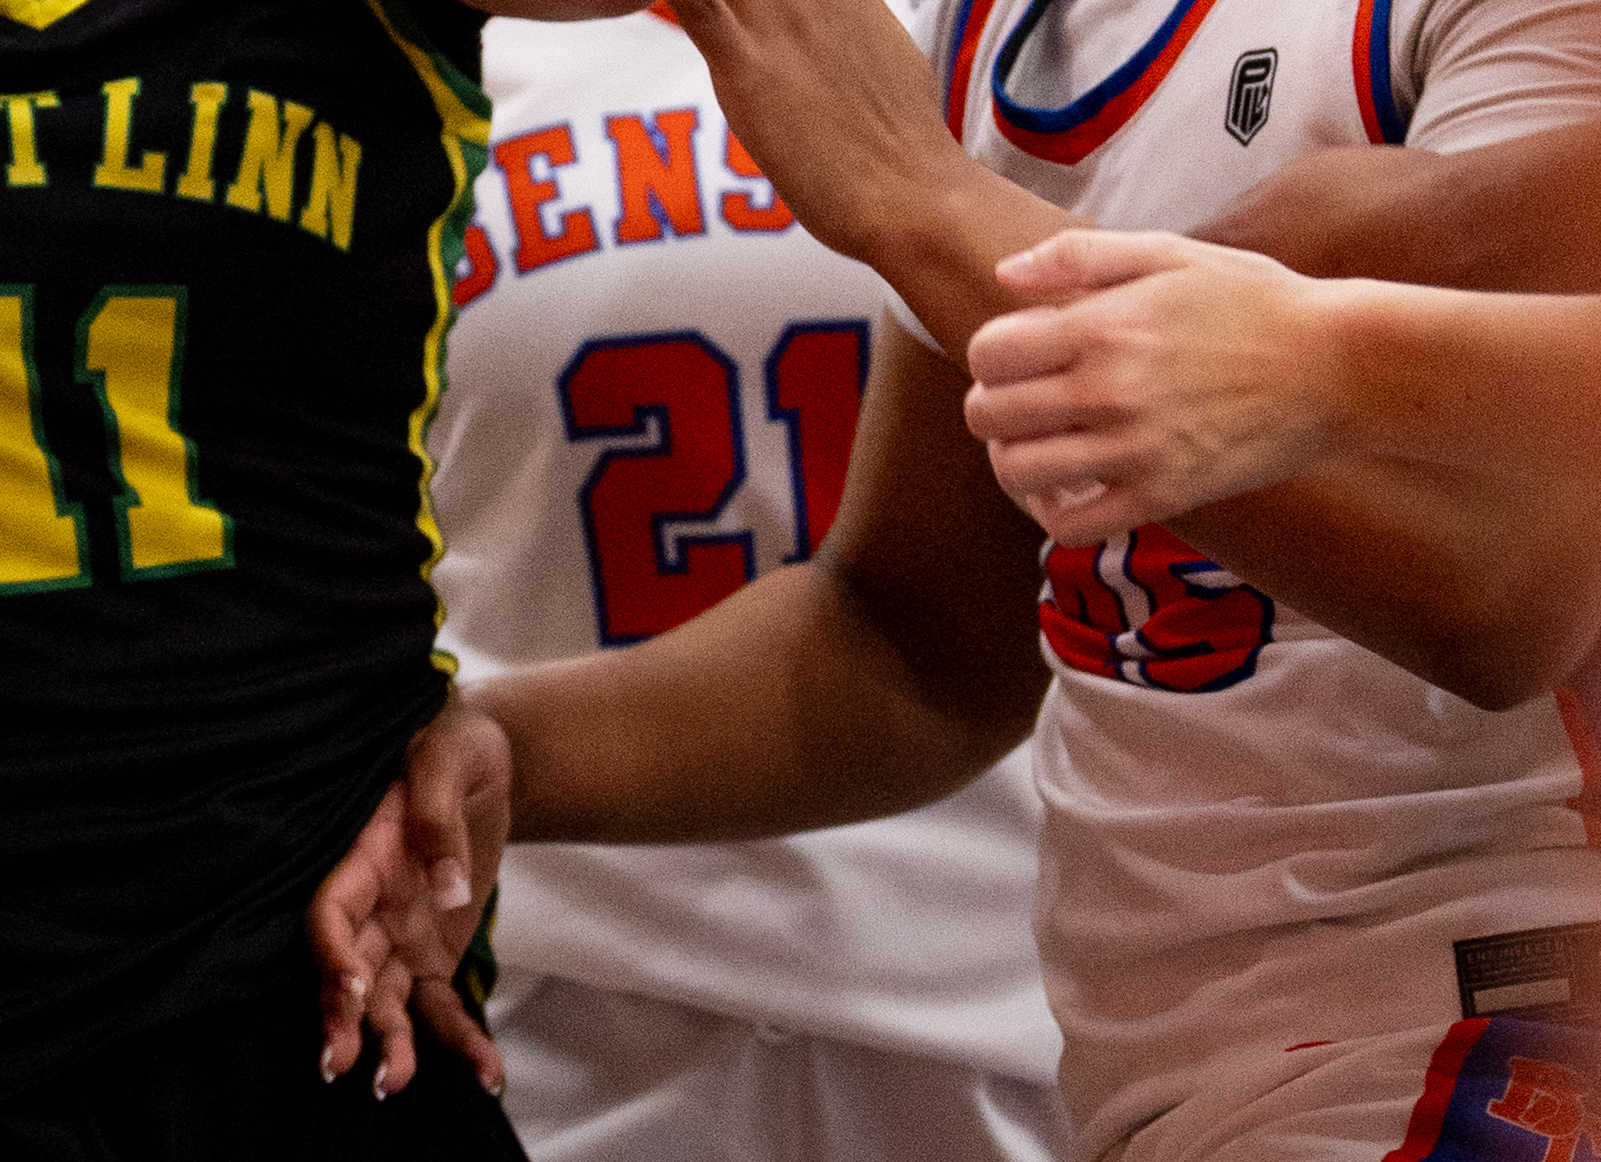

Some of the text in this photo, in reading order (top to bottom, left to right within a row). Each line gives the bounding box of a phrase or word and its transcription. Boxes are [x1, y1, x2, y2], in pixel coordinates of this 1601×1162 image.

[92, 76, 363, 253] LINN
[453, 106, 799, 308] ENS
[557, 318, 872, 650] 21
